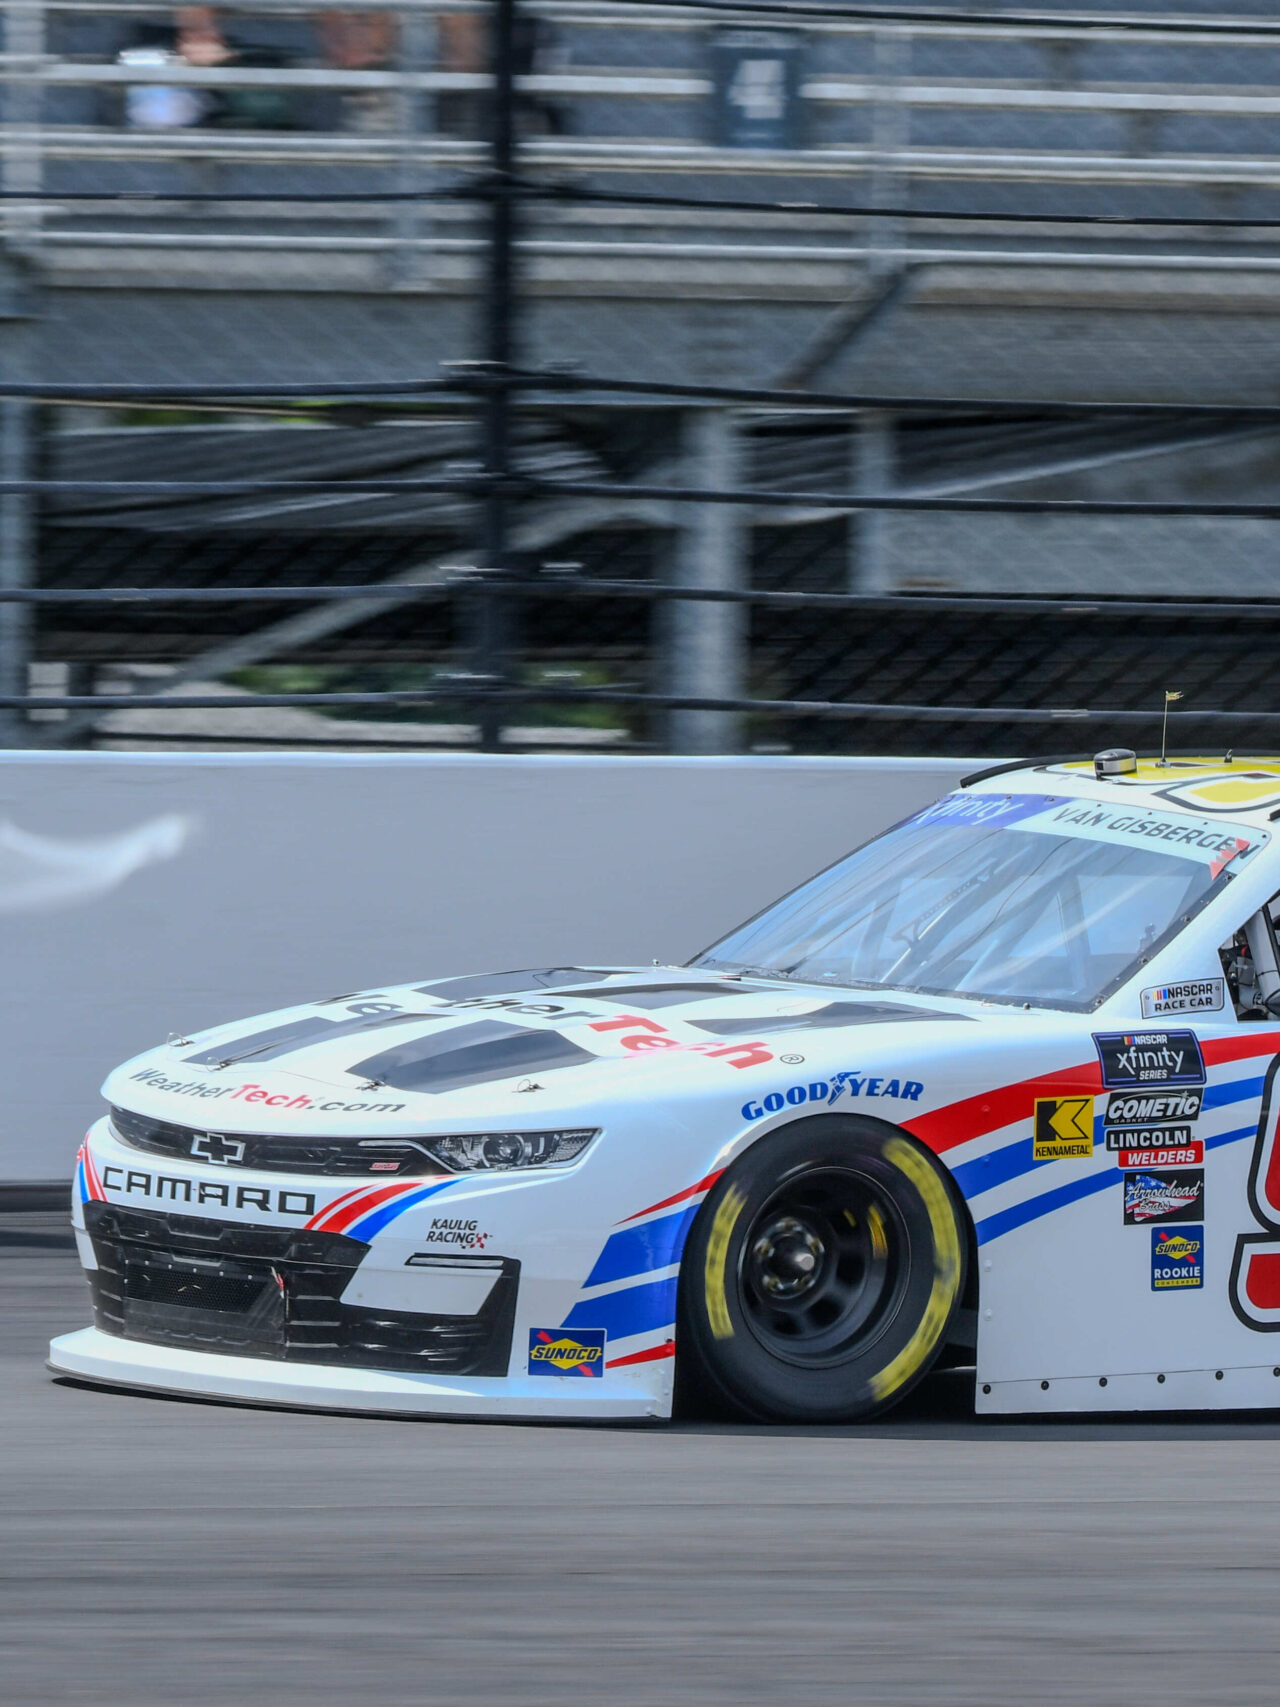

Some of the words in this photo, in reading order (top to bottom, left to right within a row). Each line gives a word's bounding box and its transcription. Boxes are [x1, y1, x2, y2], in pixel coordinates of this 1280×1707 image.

[1053, 807, 1102, 828] VAN
[1167, 983, 1213, 999] NASCAR
[1154, 1000, 1186, 1012] RACE
[1189, 997, 1213, 1007] CAR
[1133, 1034, 1168, 1045] NASCAR
[1116, 1046, 1184, 1075] xfinity
[1139, 1070, 1168, 1080] SERIES
[128, 1067, 406, 1113] WeatherTech.com
[1108, 1096, 1200, 1119] COMETIC
[1109, 1130, 1187, 1149] LINCOLN
[1035, 1145, 1090, 1157] KENNAMETAL
[1128, 1149, 1196, 1165] WELDERS
[103, 1165, 316, 1216] CAMARO
[1125, 1180, 1201, 1201] Arrowhead
[430, 1218, 478, 1231] KAULIG
[426, 1231, 476, 1244] RACING
[1157, 1242, 1199, 1254] SUNOCO
[1154, 1266, 1201, 1279] ROOKIE
[533, 1346, 599, 1361] SUNOCO
